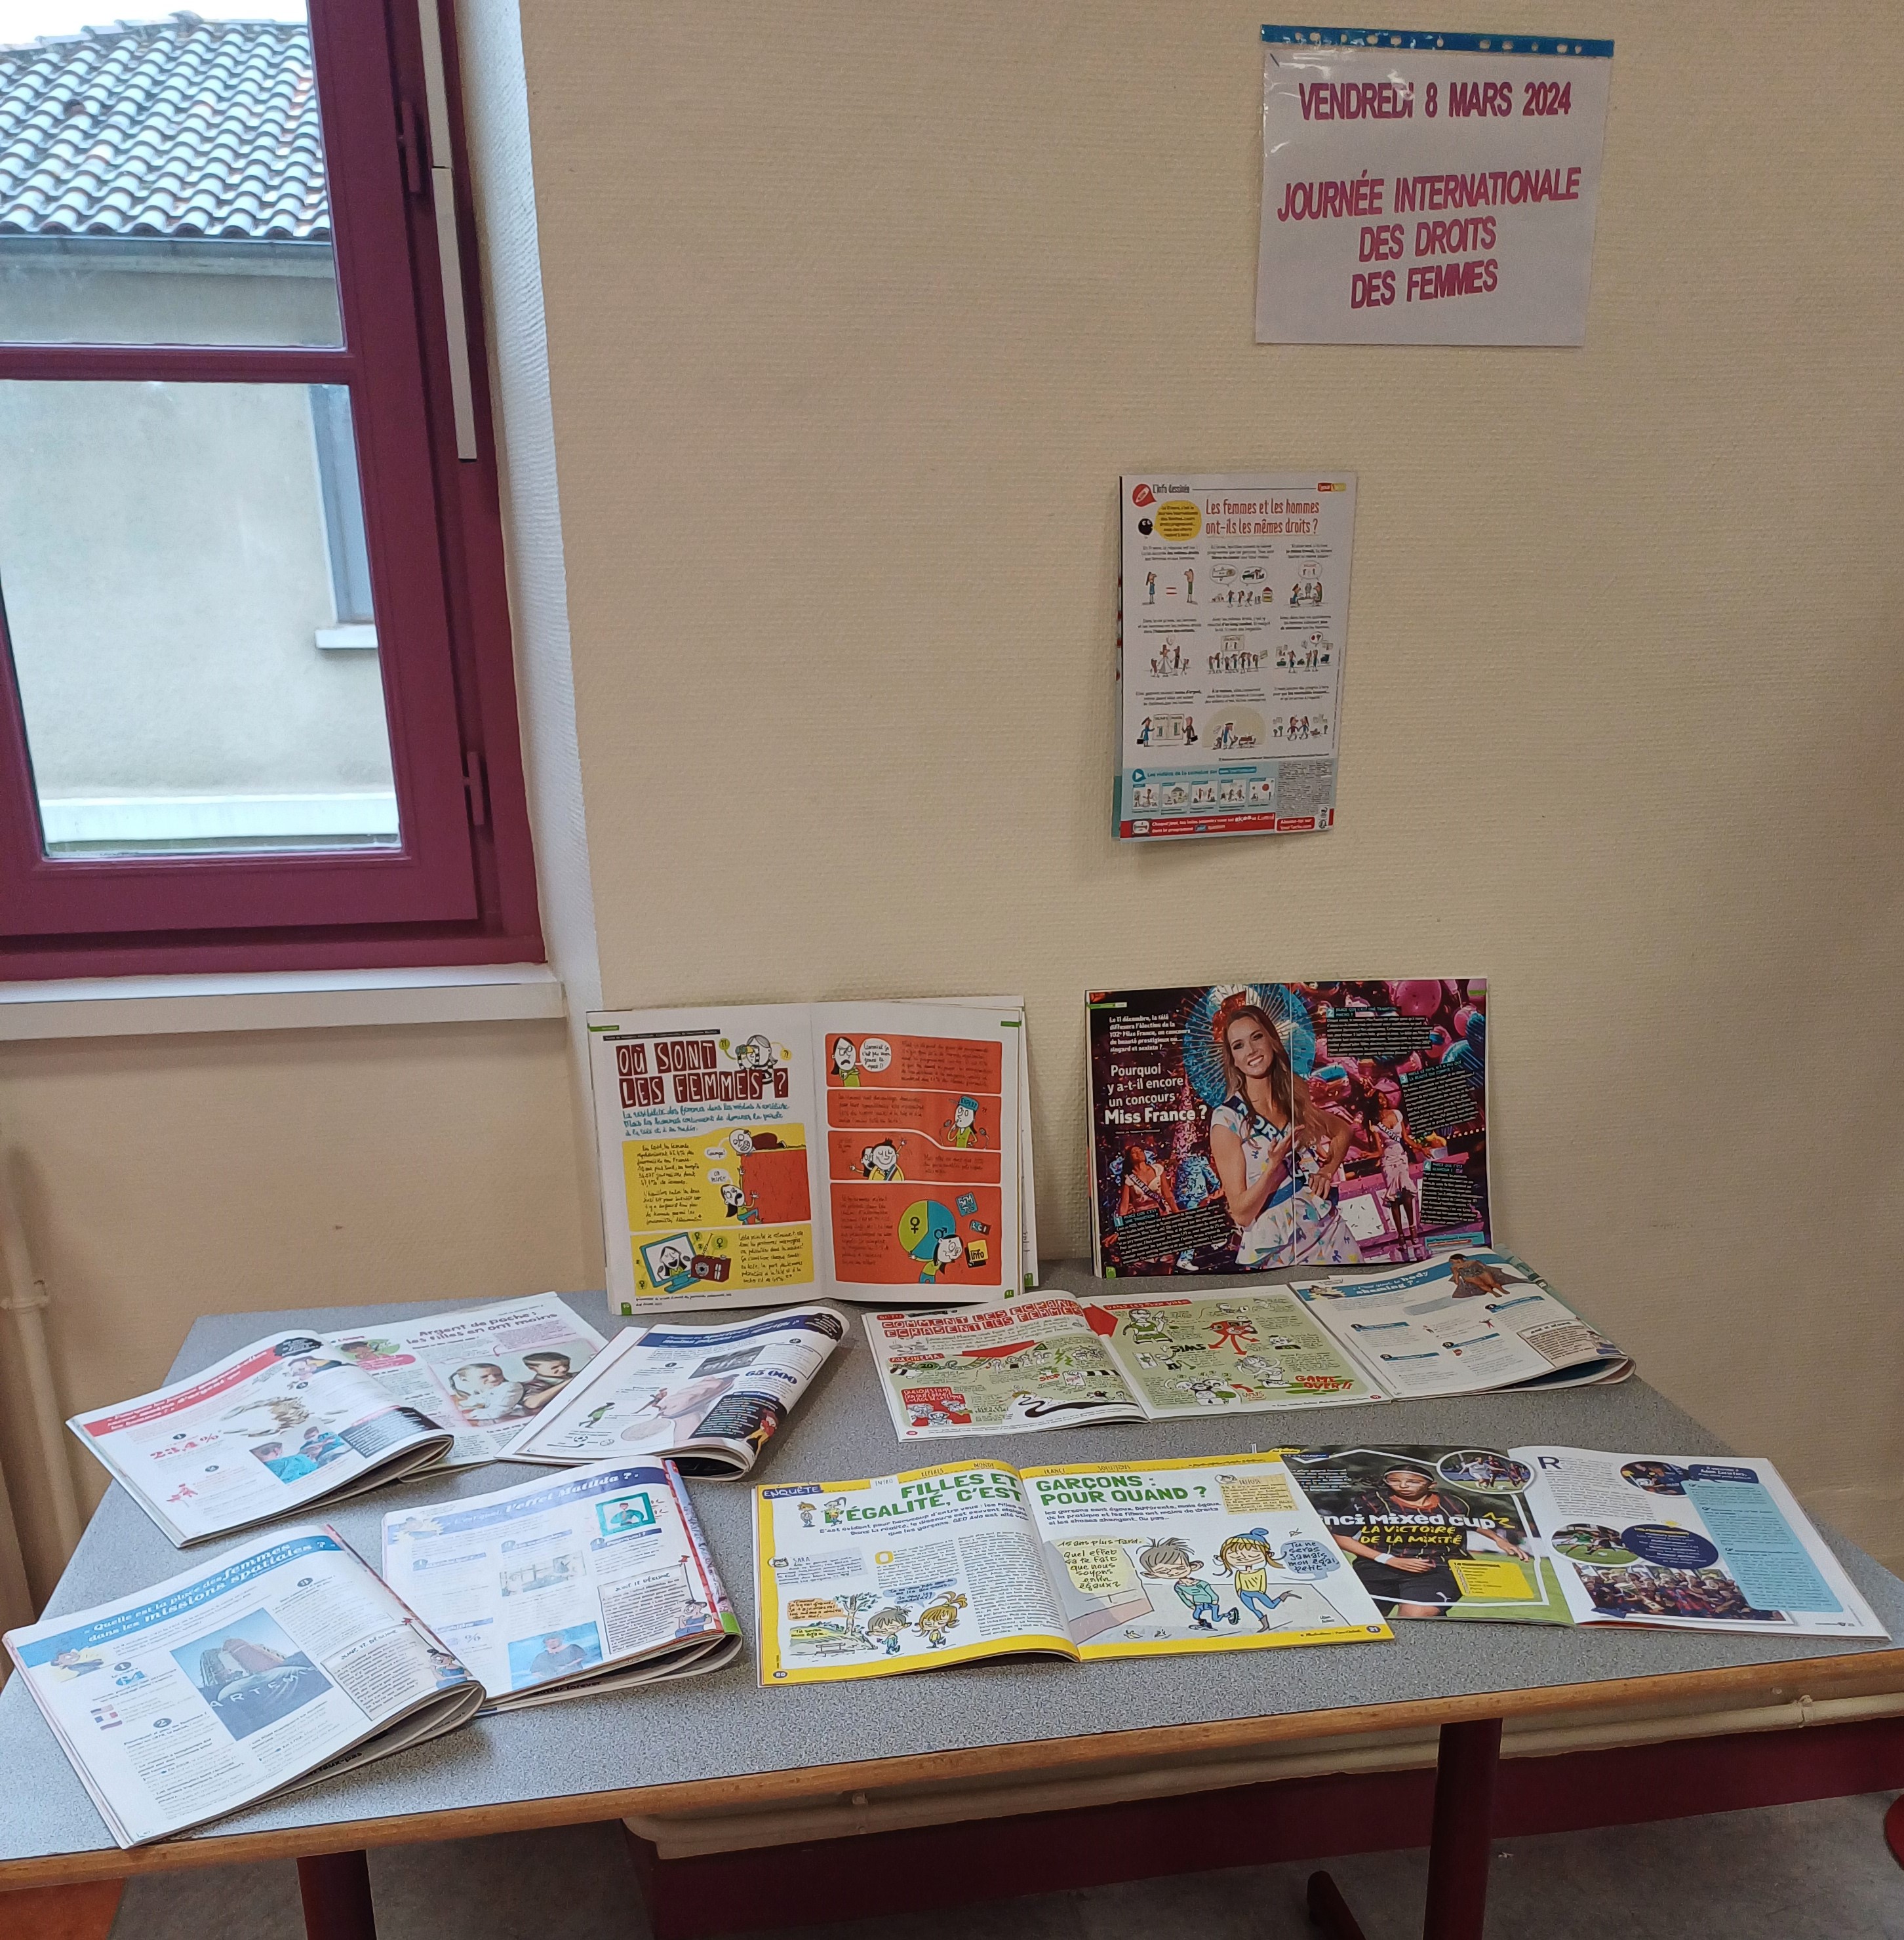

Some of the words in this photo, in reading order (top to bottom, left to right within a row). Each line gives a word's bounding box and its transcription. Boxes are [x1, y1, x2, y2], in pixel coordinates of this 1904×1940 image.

[1299, 82, 1414, 120] VENDREDI
[1425, 82, 1438, 118] 8
[1449, 82, 1512, 117] MARS
[1523, 81, 1571, 115] 2024
[1278, 169, 1384, 222] JOURNÉE
[1395, 167, 1581, 213] INTERNATIONALE
[1359, 224, 1404, 262] DES
[1415, 216, 1496, 256] DROITS
[1351, 270, 1395, 309] DES
[1407, 259, 1498, 302] FEMMES
[1206, 499, 1220, 515] Les
[1223, 498, 1257, 515] femmes
[1259, 500, 1269, 515] et
[1271, 498, 1283, 514] les
[1286, 498, 1319, 514] hommes
[1206, 518, 1237, 534] ont-ils
[1239, 518, 1252, 534] les
[1254, 518, 1283, 534] mêmes
[1285, 517, 1311, 533] droits
[1313, 518, 1319, 534] ?
[618, 1046, 646, 1074] OÙ
[656, 1041, 715, 1071] SONT
[1111, 1062, 1161, 1078] Pourquoi
[621, 1077, 663, 1106] LES
[675, 1072, 761, 1101] FEMMES
[776, 1071, 787, 1095] ?
[1107, 1083, 1114, 1096] y
[1117, 1078, 1143, 1092] a-t-il
[1146, 1077, 1184, 1089] encore
[1109, 1098, 1123, 1107] un
[1125, 1092, 1176, 1105] concours
[1104, 1109, 1141, 1125] Miss
[1144, 1107, 1196, 1123] France
[1199, 1104, 1208, 1120] ?
[1400, 1271, 1429, 1282] body
[420, 1324, 466, 1337] Argent
[489, 1313, 530, 1325] poche
[430, 1331, 464, 1341] filles
[488, 1322, 512, 1330] ont
[515, 1313, 558, 1326] moins
[882, 1316, 968, 1329] COMMENT
[973, 1310, 1008, 1322] LES
[982, 1316, 1014, 1330] LES
[1018, 1307, 1084, 1322] FEMMES
[1537, 1455, 1561, 1470] R
[557, 1474, 620, 1498] Matilda
[763, 1484, 821, 1497] ENQUÊTE
[901, 1473, 984, 1499] FILLES
[990, 1473, 1018, 1488] ET
[1035, 1475, 1143, 1492] GARÇONS
[956, 1487, 1023, 1502] C'EST
[1039, 1490, 1108, 1507] POUR
[1110, 1486, 1189, 1503] QUAND
[1193, 1486, 1207, 1498] ?
[1449, 1515, 1496, 1530] cup
[1091, 1538, 1113, 1547] plus
[1063, 1549, 1085, 1558] Quel
[1070, 1564, 1089, 1574] que
[88, 1627, 120, 1642] dans
[122, 1619, 140, 1631] les
[144, 1581, 227, 1623] missions
[231, 1544, 313, 1583] spatiales
[92, 1612, 131, 1631] Quelle
[135, 1606, 152, 1617] est
[155, 1600, 167, 1610] la
[203, 1576, 222, 1588] des
[222, 1543, 291, 1581] femmes
